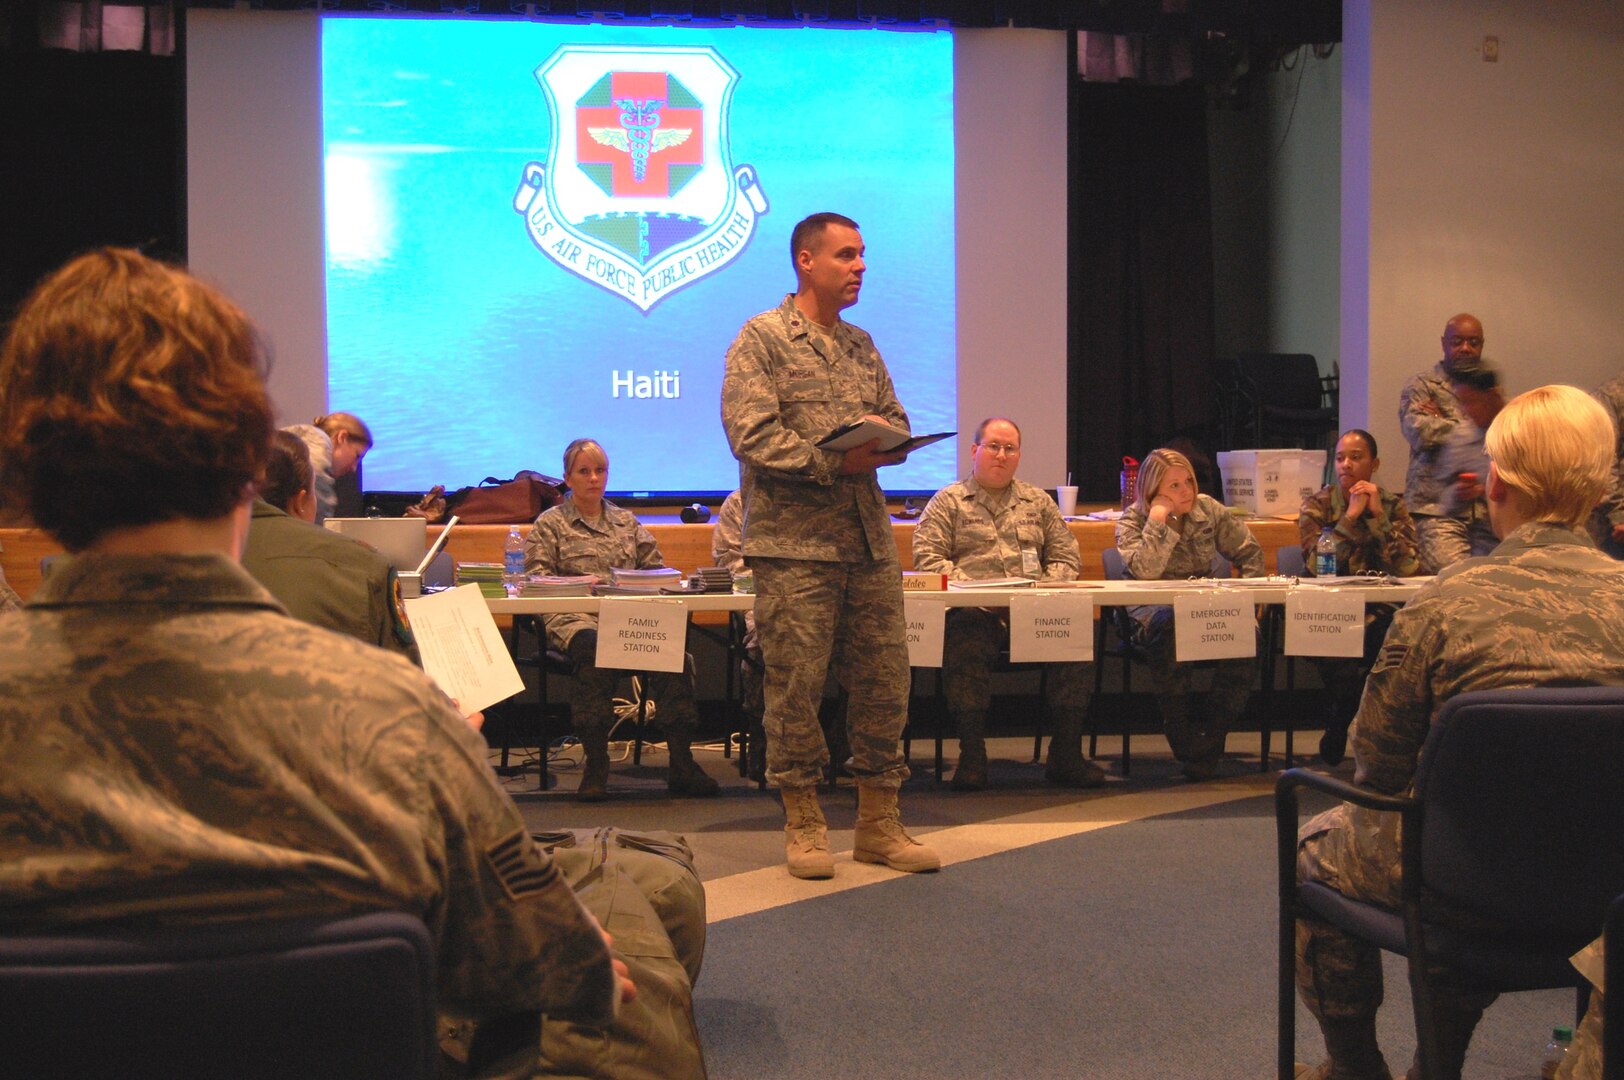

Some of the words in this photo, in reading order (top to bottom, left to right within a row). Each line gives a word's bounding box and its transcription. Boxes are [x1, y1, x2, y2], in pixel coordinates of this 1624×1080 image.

[551, 238, 582, 264] AIR
[585, 253, 636, 297] FORCE
[642, 255, 696, 300] PUBLIC
[695, 210, 750, 269] HEALTH
[611, 369, 681, 399] Haiti
[1191, 608, 1241, 619] EMERGENCY
[1294, 613, 1356, 622] IDENTIFICATION
[628, 617, 659, 628] FAMILY
[1034, 617, 1071, 627] FINANCE
[1206, 622, 1227, 631] DATA
[1308, 624, 1342, 634] STATION
[618, 630, 667, 641] READINESS
[1035, 630, 1071, 639] STATION
[1201, 633, 1235, 643] STATION
[623, 643, 660, 653] STATION
